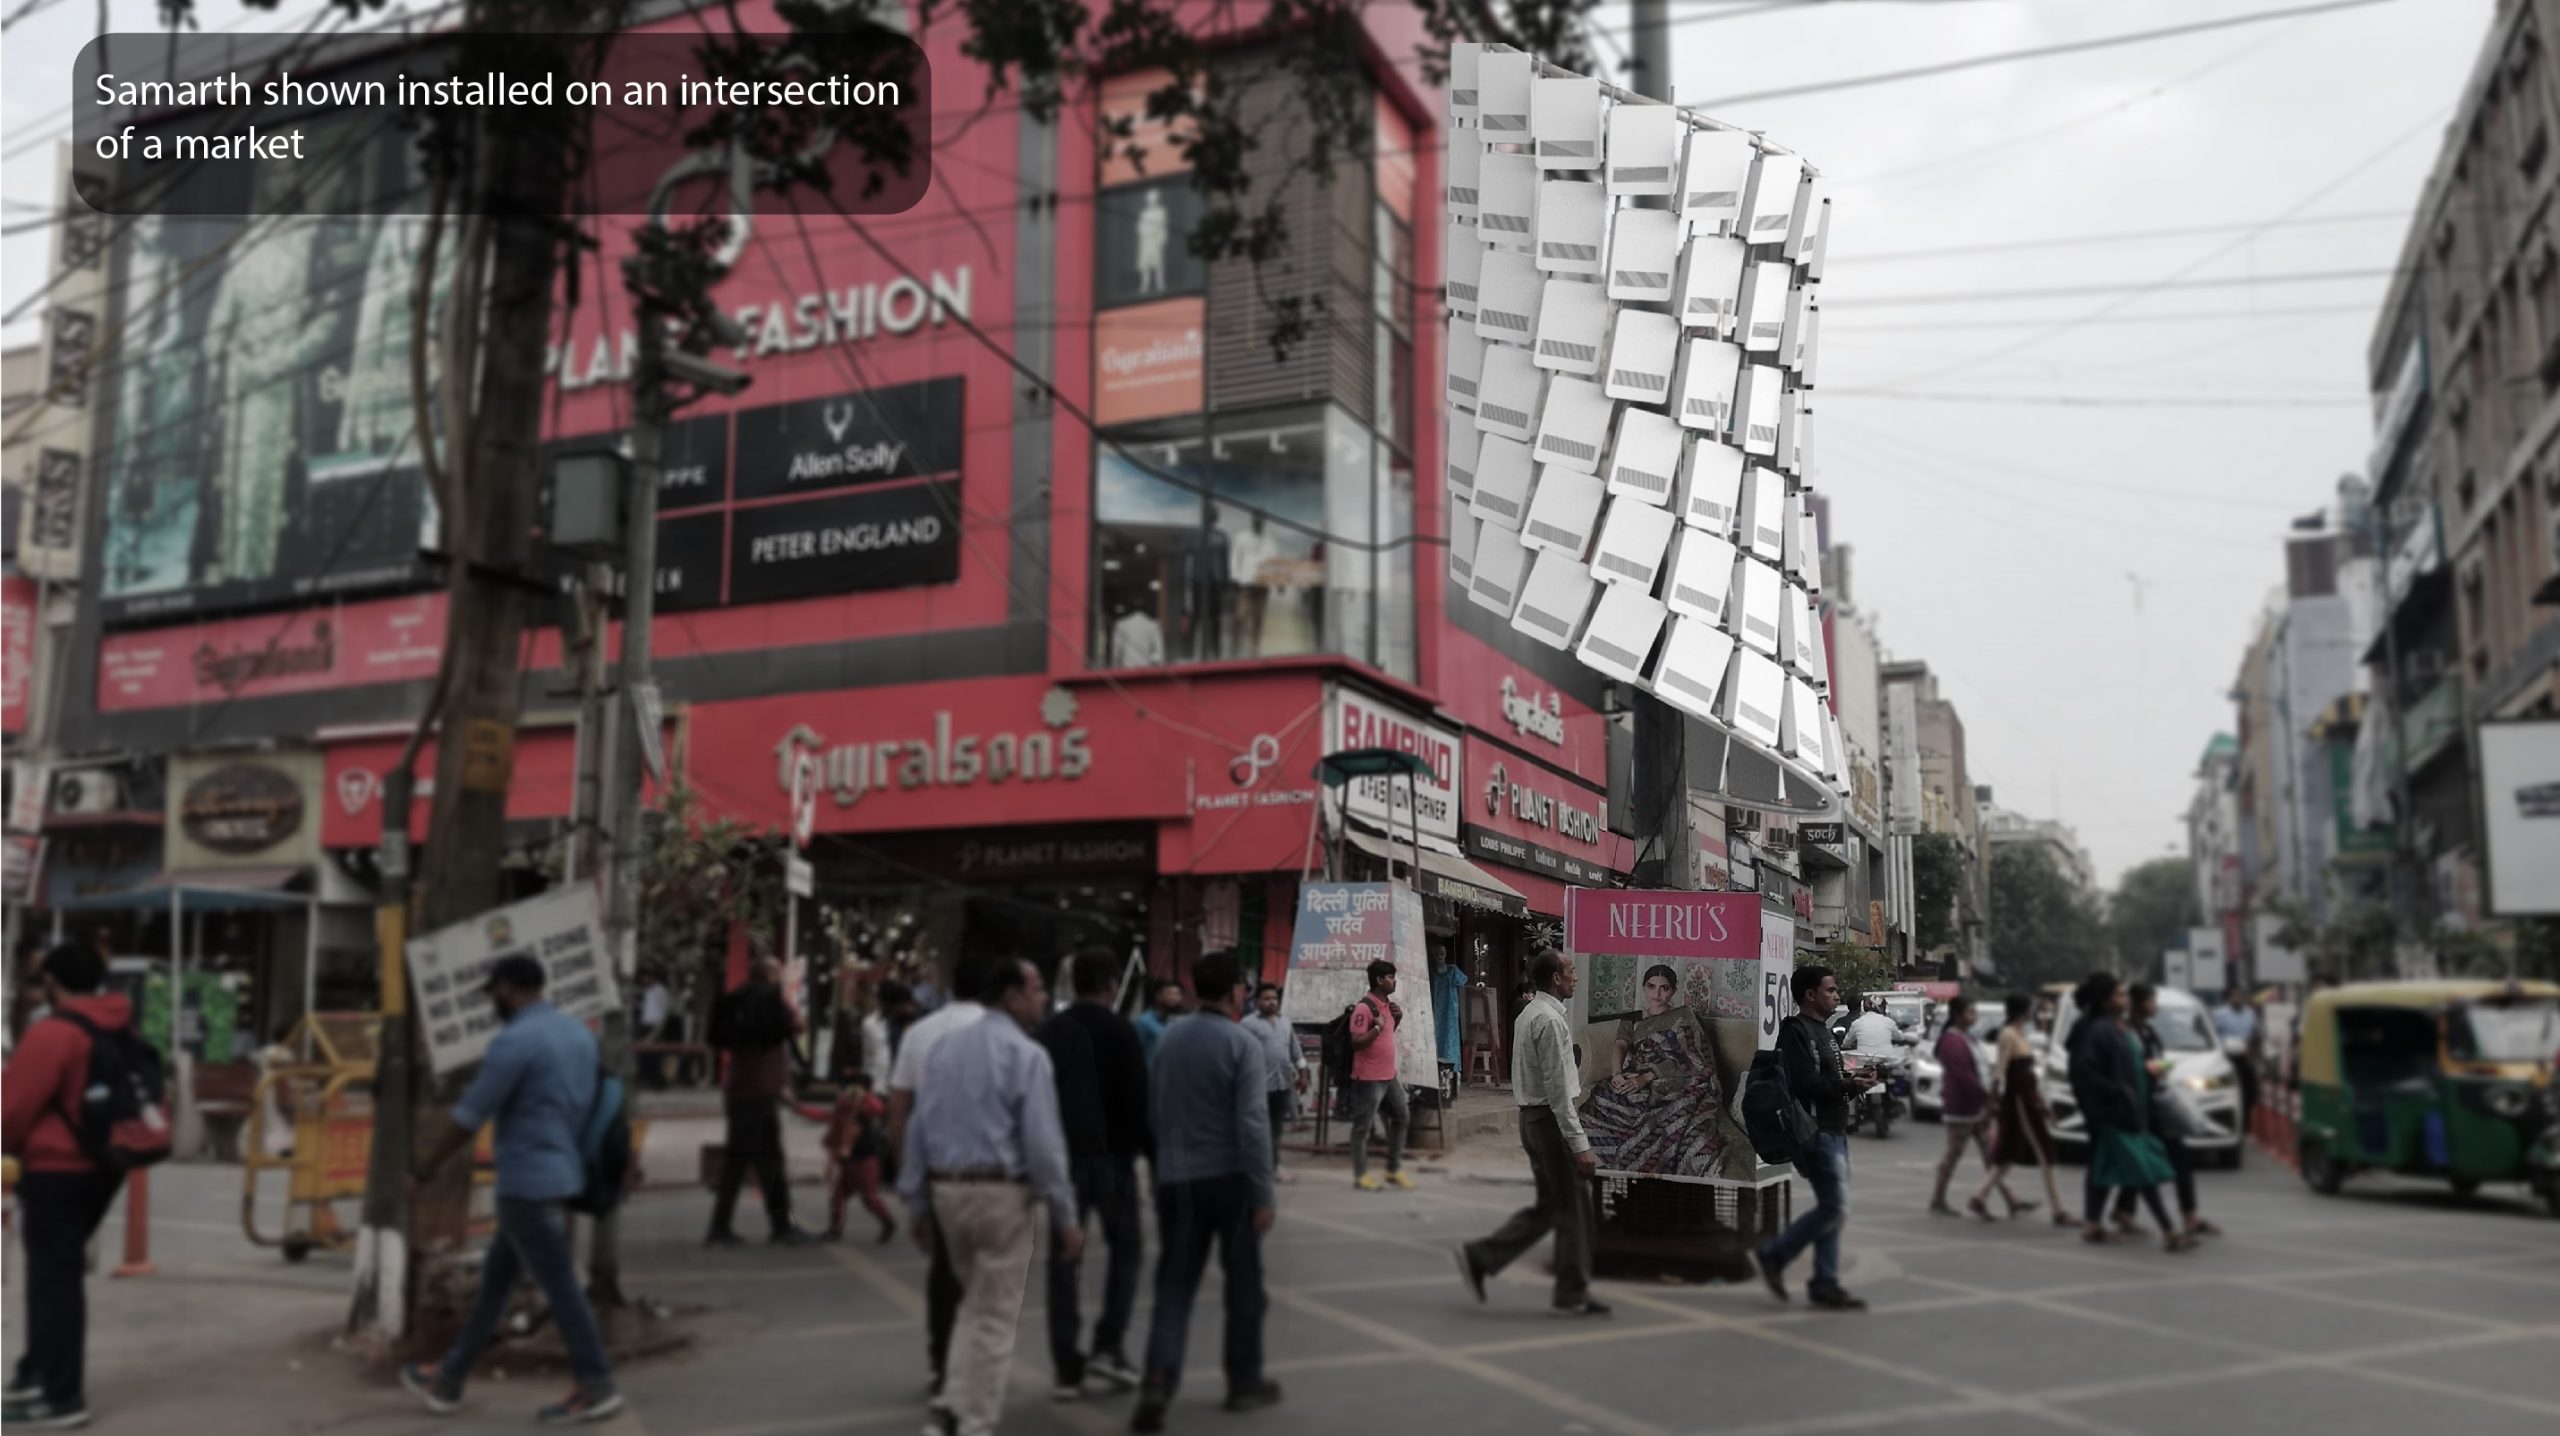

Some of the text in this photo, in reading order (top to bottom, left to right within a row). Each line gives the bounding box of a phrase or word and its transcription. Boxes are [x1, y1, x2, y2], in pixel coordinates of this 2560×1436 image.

[735, 265, 972, 361] FASHION
[787, 439, 906, 482] Allen Solly
[751, 515, 941, 565] PETER ENGLAND
[1344, 704, 1452, 791] BAMBINO
[1196, 791, 1249, 809] PLANET
[1511, 782, 1600, 844] PLANET FASHION
[1306, 888, 1349, 913] दिल्ली
[1437, 877, 1478, 902] BAMBINO
[1325, 912, 1365, 936] सदैव
[1607, 902, 1728, 943] NEERU'S
[1298, 939, 1388, 961] आपके साथ
[1354, 1013, 1365, 1028] 8
[1763, 972, 1790, 1036] 50
